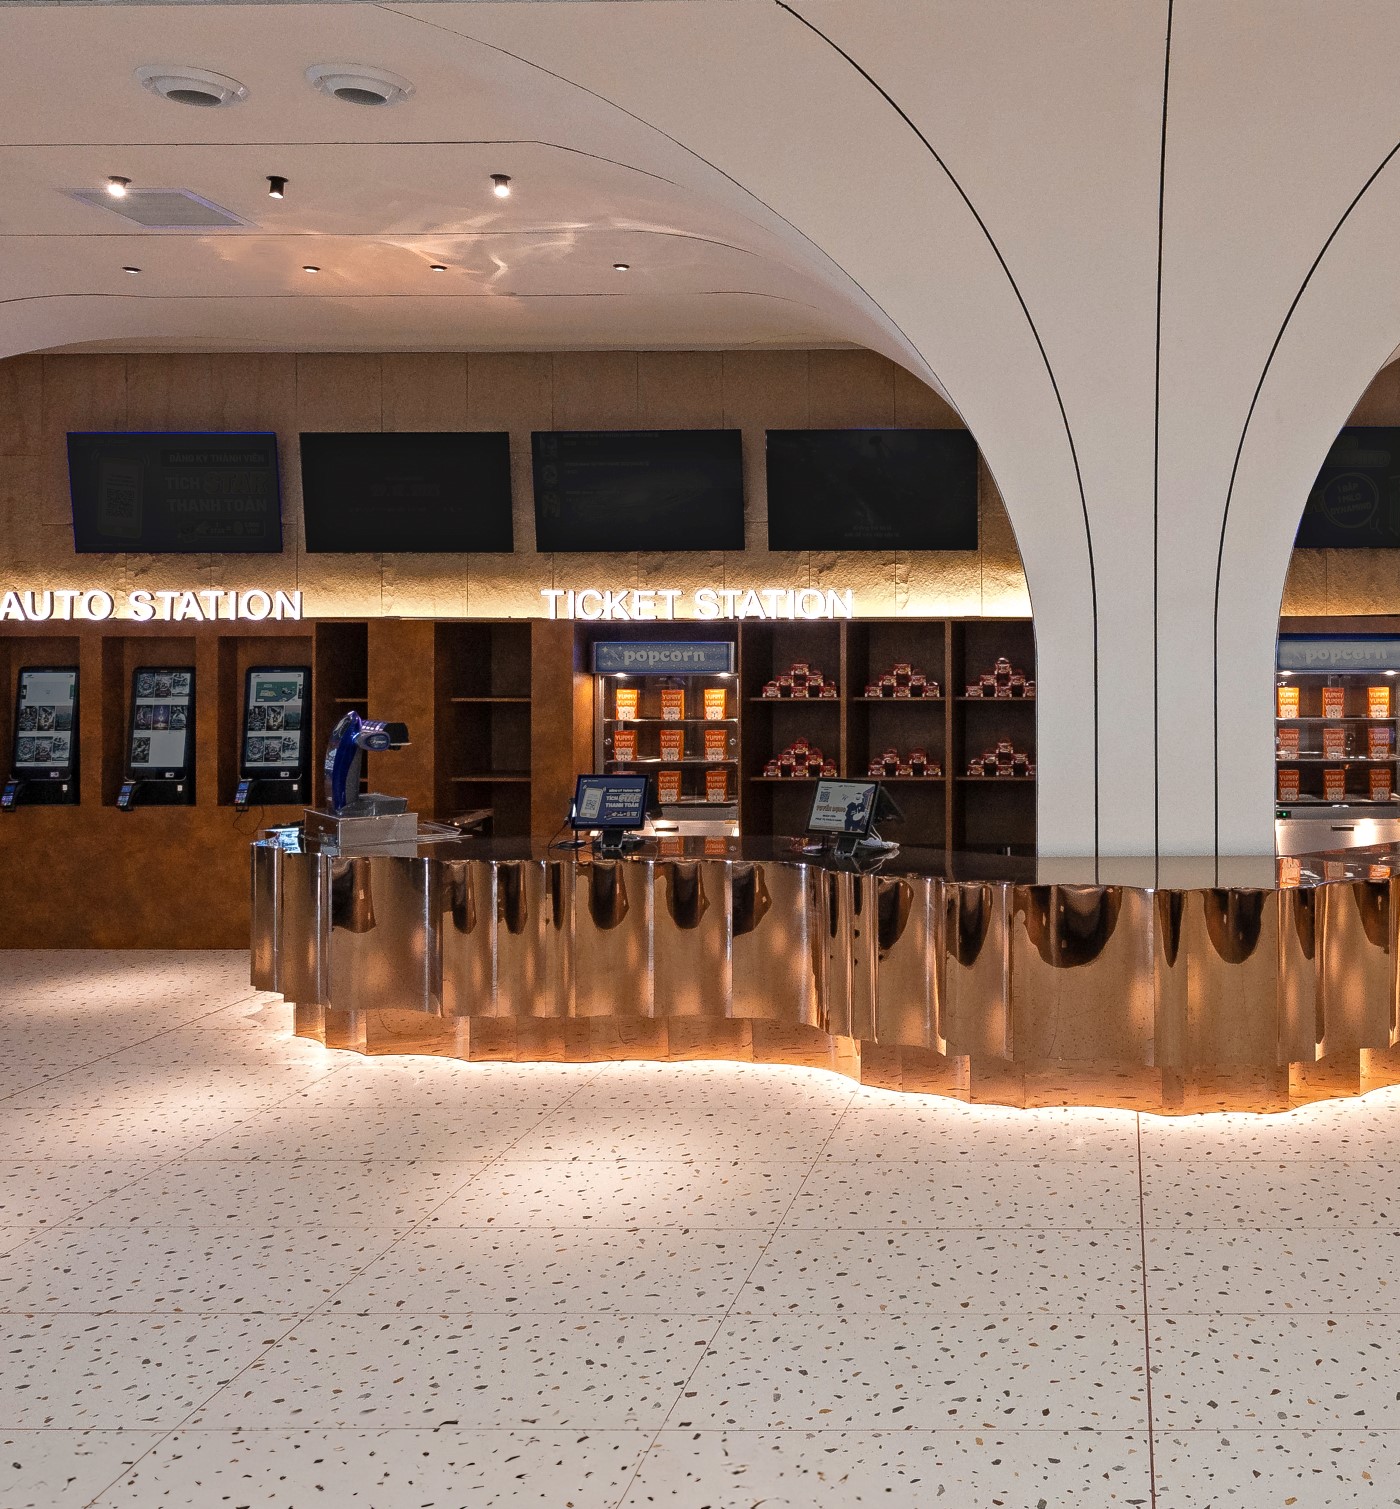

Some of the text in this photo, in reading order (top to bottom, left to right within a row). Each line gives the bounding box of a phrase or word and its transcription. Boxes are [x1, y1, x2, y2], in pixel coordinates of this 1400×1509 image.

[165, 472, 200, 490] TÍCH
[0, 590, 303, 621] AUTO STATION
[541, 588, 853, 620] TICKET STATION
[623, 650, 706, 666] popcorn
[1304, 647, 1388, 664] popcorn
